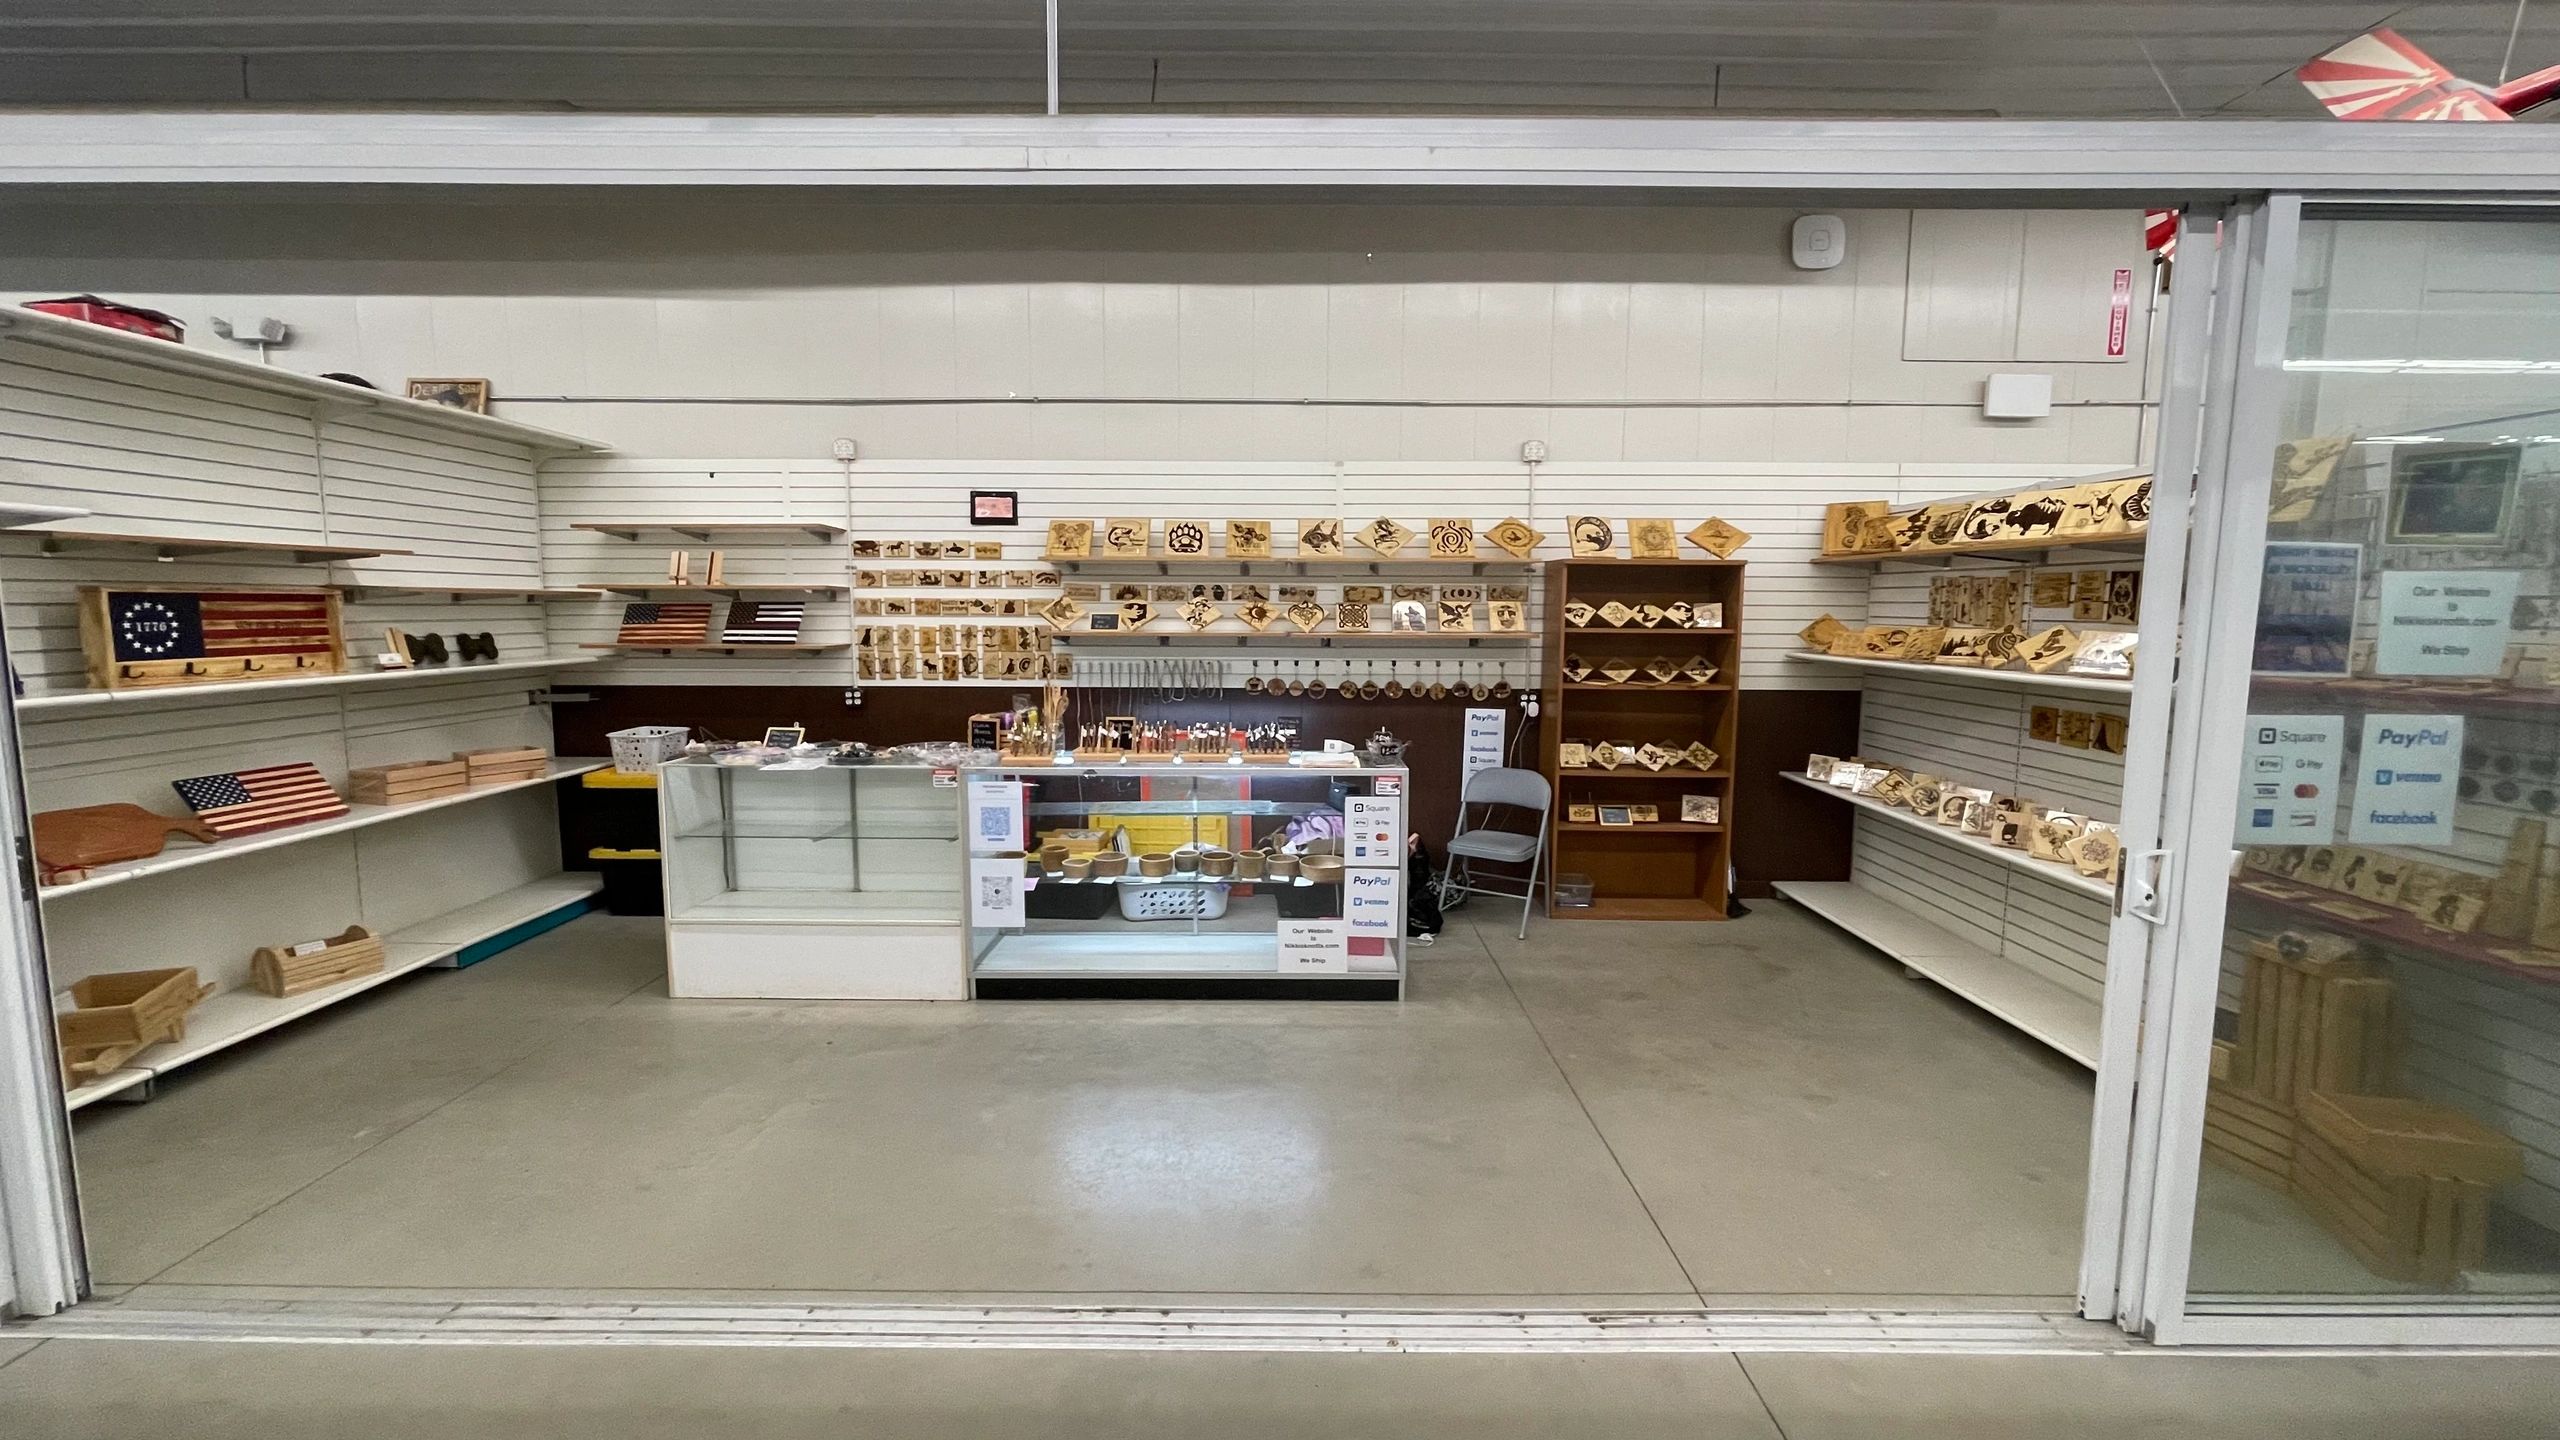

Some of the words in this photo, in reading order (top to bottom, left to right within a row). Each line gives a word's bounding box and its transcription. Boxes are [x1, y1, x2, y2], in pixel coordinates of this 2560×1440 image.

[2412, 586, 2438, 597] Our
[135, 621, 168, 632] 1776
[2421, 645, 2441, 655] We
[1471, 713, 1499, 722] PayPal
[2280, 731, 2327, 744] Square
[2378, 729, 2449, 748] PayPal
[2396, 773, 2442, 783] venmo
[1365, 804, 1391, 813] Square
[2370, 810, 2437, 825] facebook
[1353, 876, 1391, 887] PayPal
[1352, 919, 1389, 928] facebook
[1311, 957, 1326, 965] Ship
